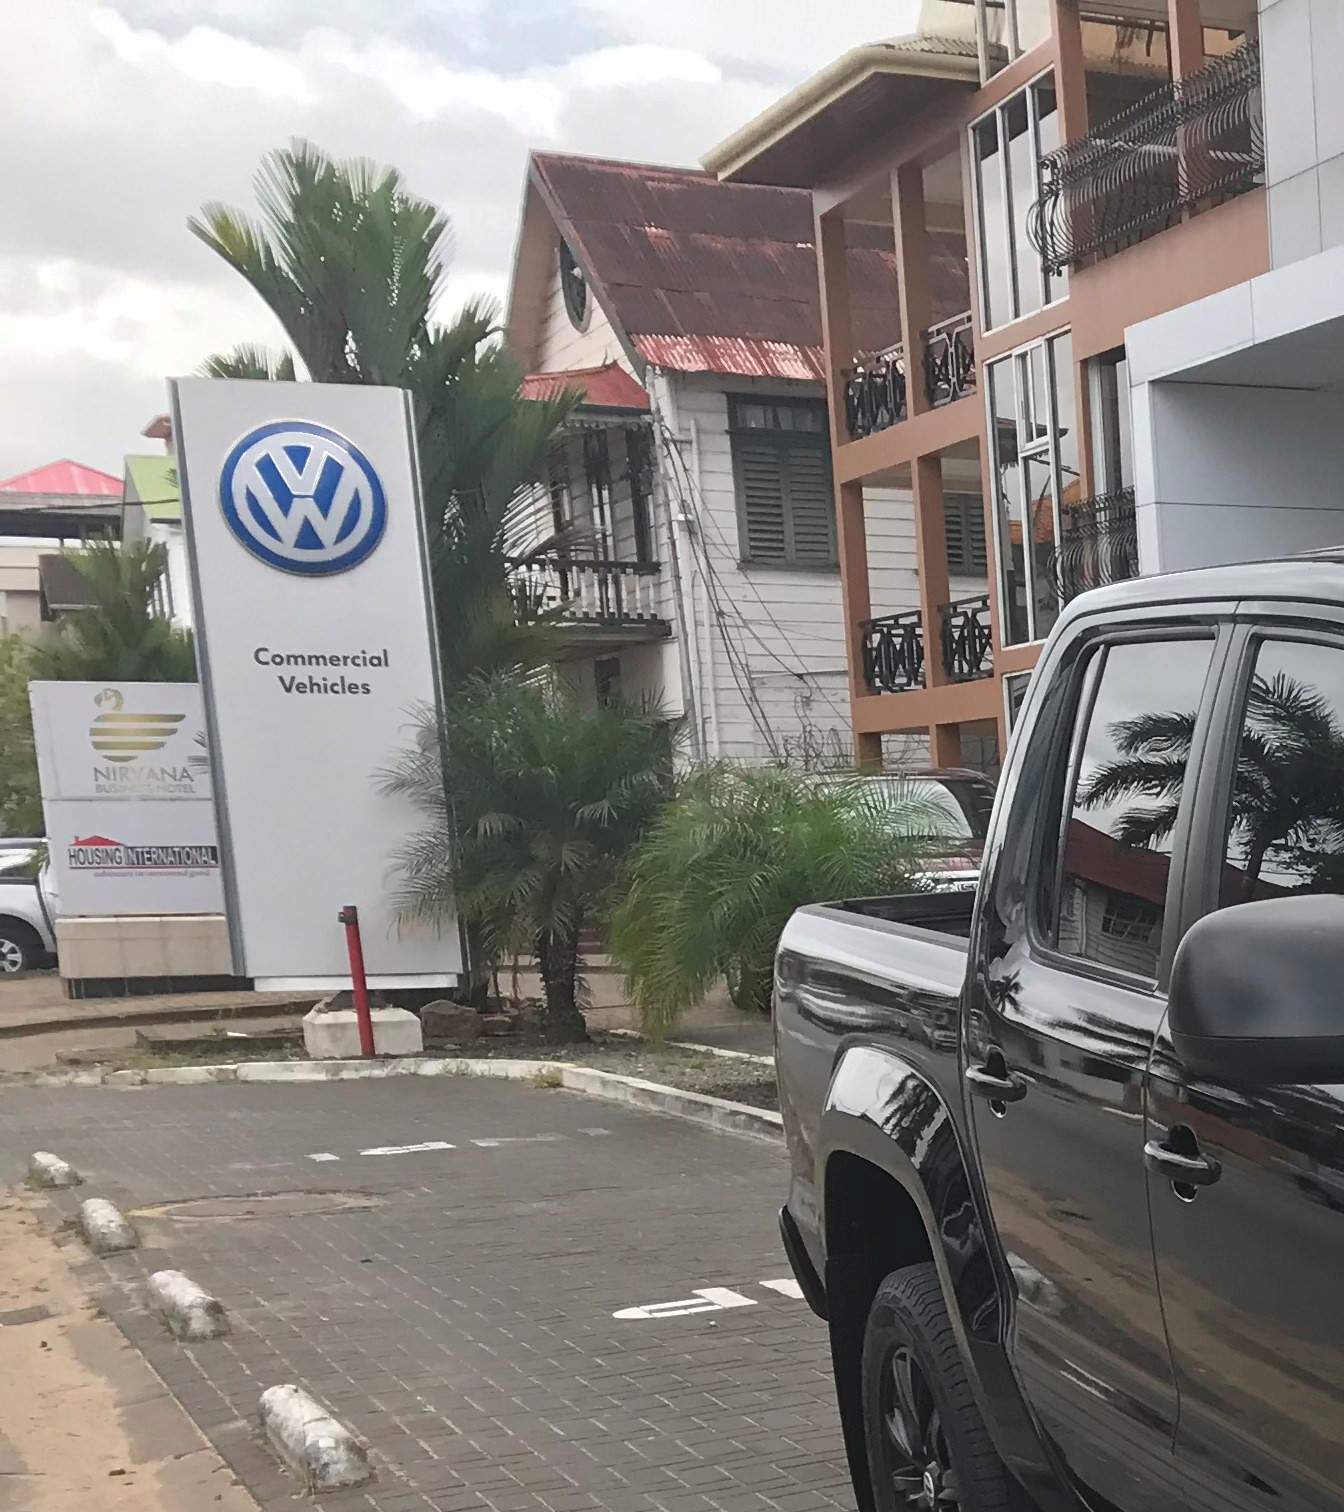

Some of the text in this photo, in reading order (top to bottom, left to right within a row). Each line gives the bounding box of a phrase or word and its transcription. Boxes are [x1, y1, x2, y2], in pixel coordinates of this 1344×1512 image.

[253, 647, 390, 668] Commercial
[277, 674, 372, 695] Vehicles
[93, 766, 195, 783] NIRVANA
[67, 846, 218, 866] HOUSING INTERNATIONAL
